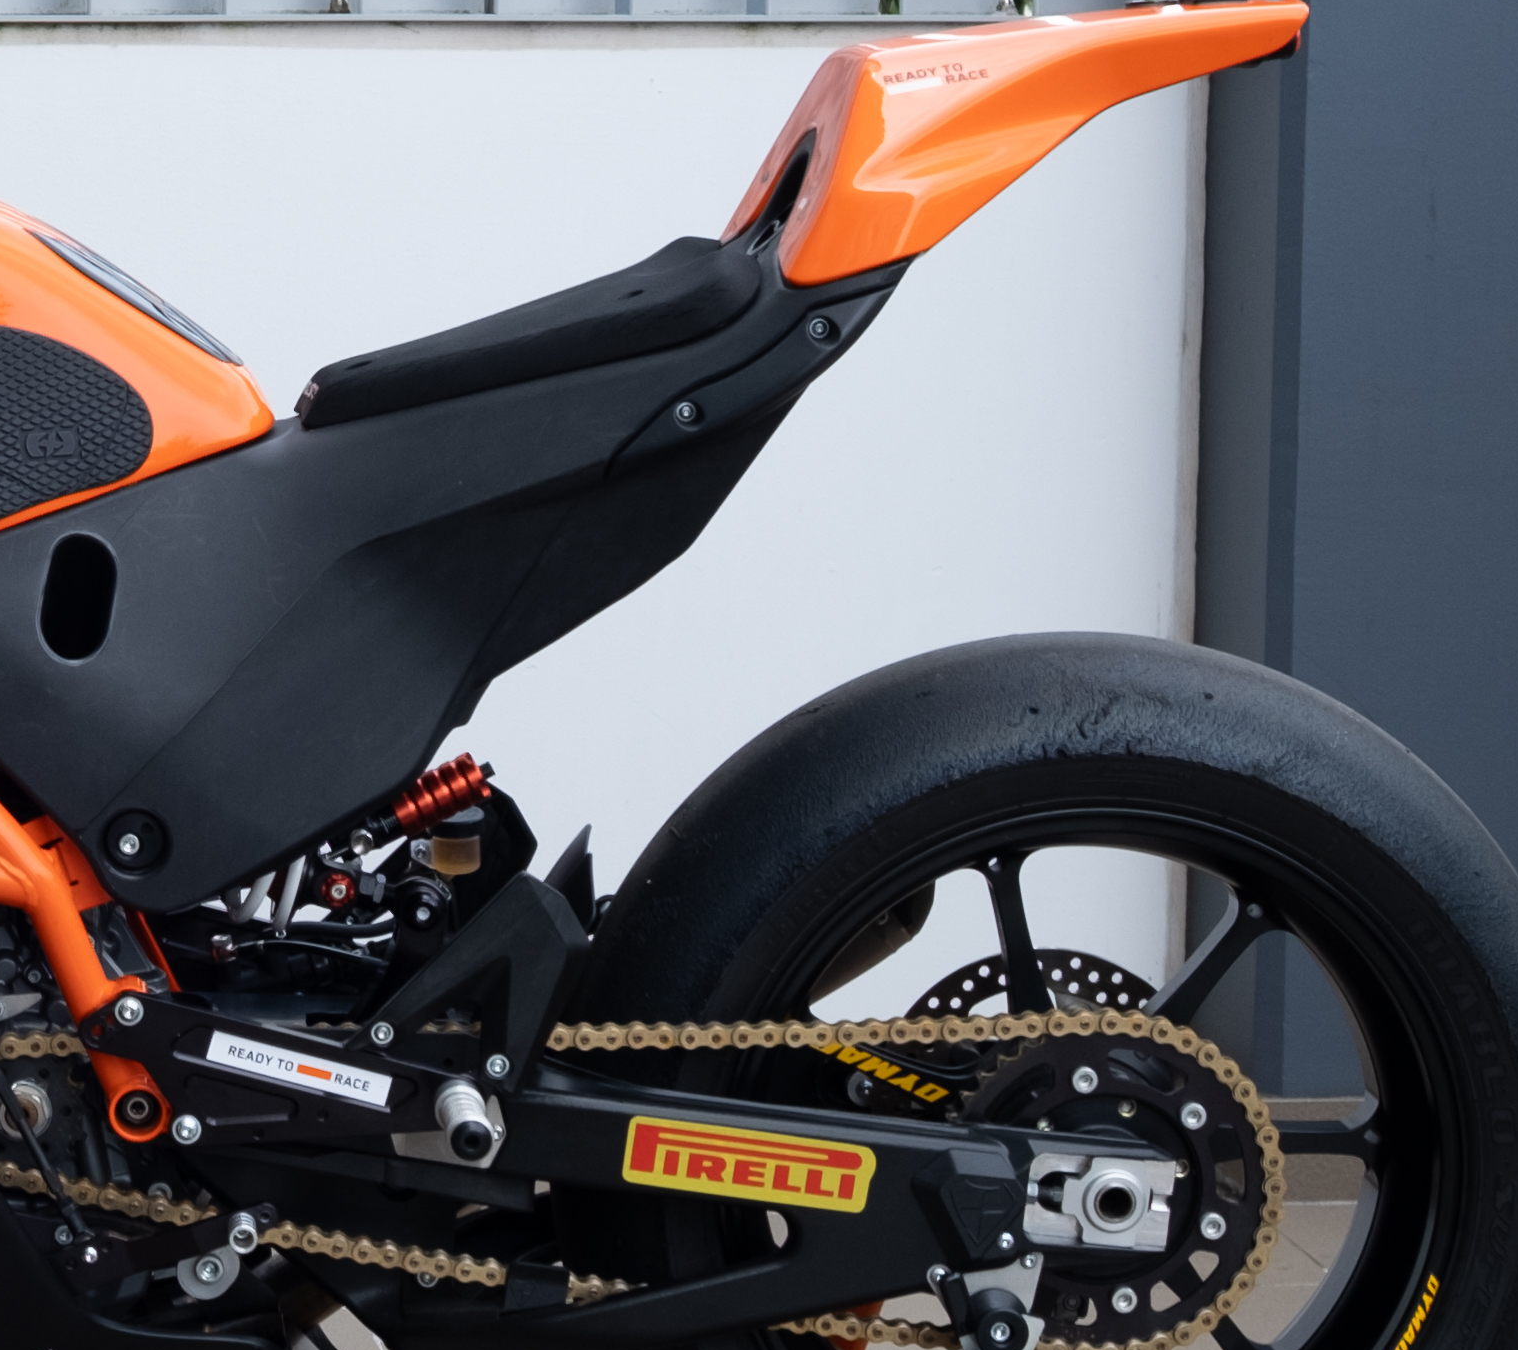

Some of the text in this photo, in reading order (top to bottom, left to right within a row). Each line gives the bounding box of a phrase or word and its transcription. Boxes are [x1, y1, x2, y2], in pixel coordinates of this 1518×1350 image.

[883, 62, 963, 85] READY TO
[945, 68, 989, 84] RACE
[228, 1045, 371, 1092] READY TO RACE
[629, 1123, 863, 1200] PIRELLI
